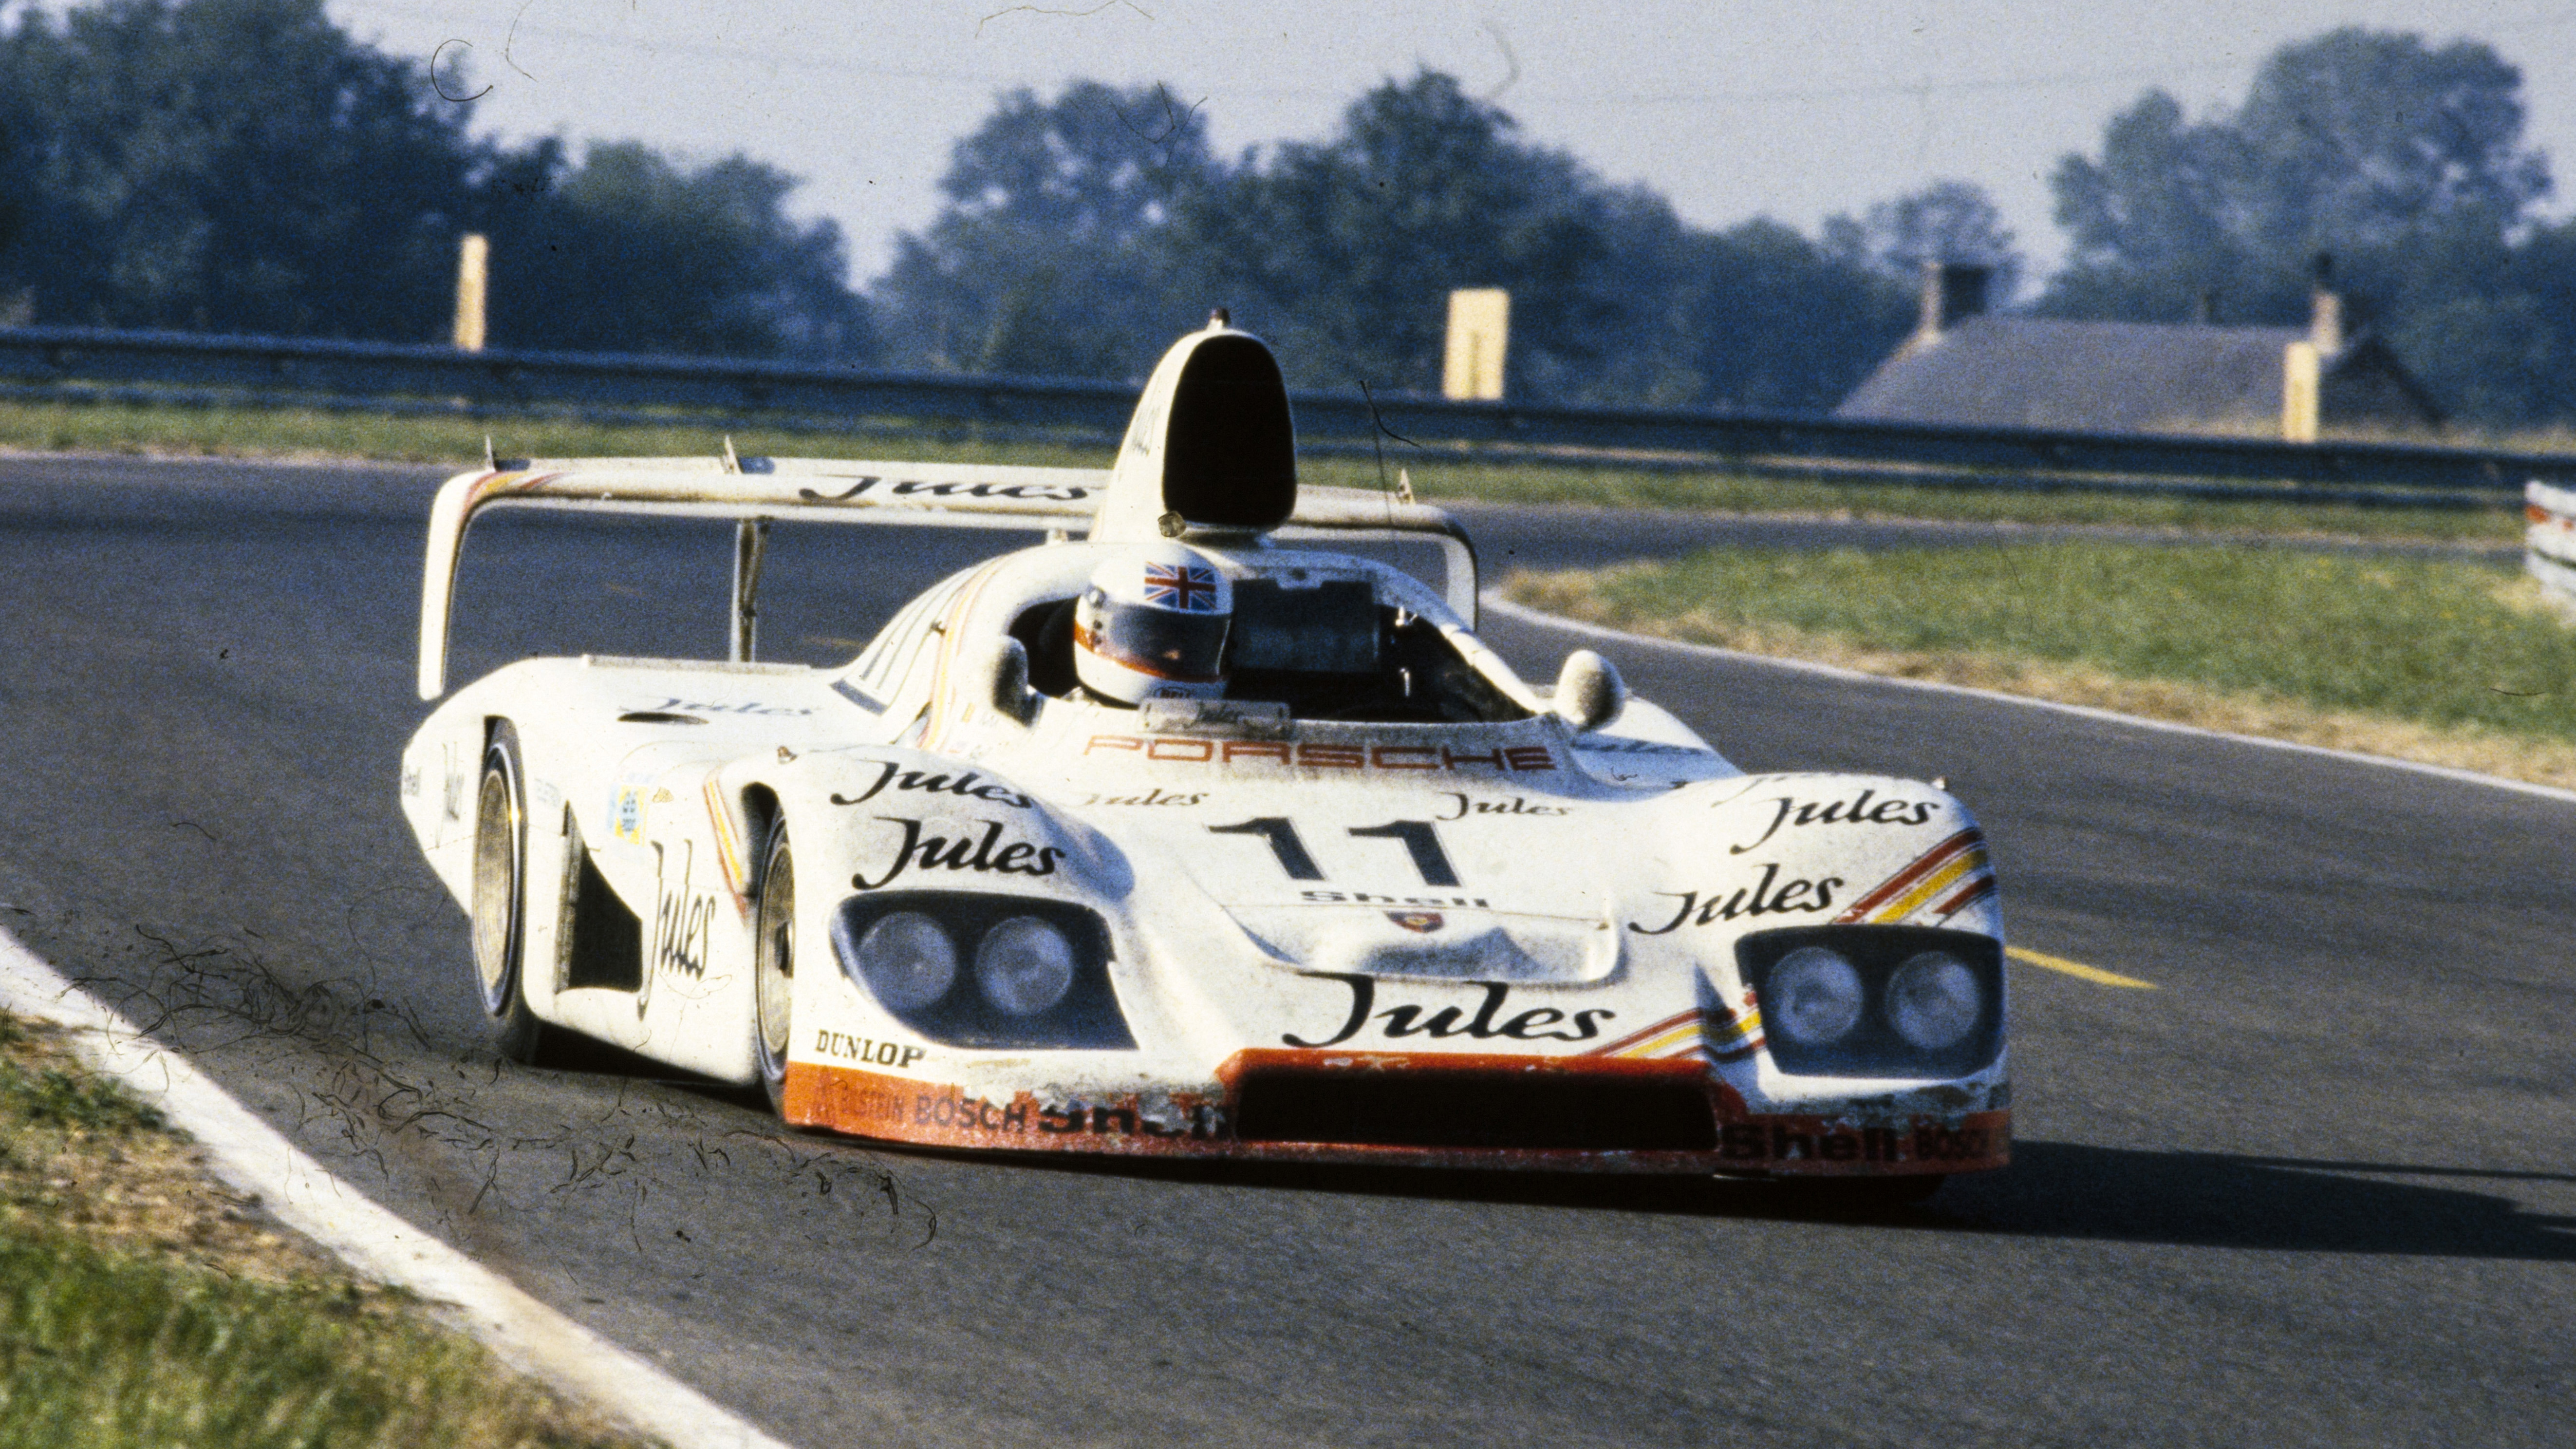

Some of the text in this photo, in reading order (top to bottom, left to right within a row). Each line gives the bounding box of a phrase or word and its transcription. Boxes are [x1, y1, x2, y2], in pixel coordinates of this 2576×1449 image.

[1083, 734, 1555, 771] PORSCHE
[830, 758, 1033, 809] Jules
[1071, 788, 1210, 806] Jules
[1436, 790, 1573, 821] Jules
[1730, 789, 1941, 855] Jules
[851, 815, 1066, 890] Jules
[1207, 815, 1466, 887] 11
[1301, 891, 1489, 908] Shell
[1626, 863, 1845, 935] Jules
[637, 838, 716, 1021] Jules
[1281, 971, 1616, 1048] Jules
[816, 1029, 927, 1069] DUNLOP
[915, 1093, 1027, 1134] BOSCH
[1721, 1123, 1899, 1161] Shell
